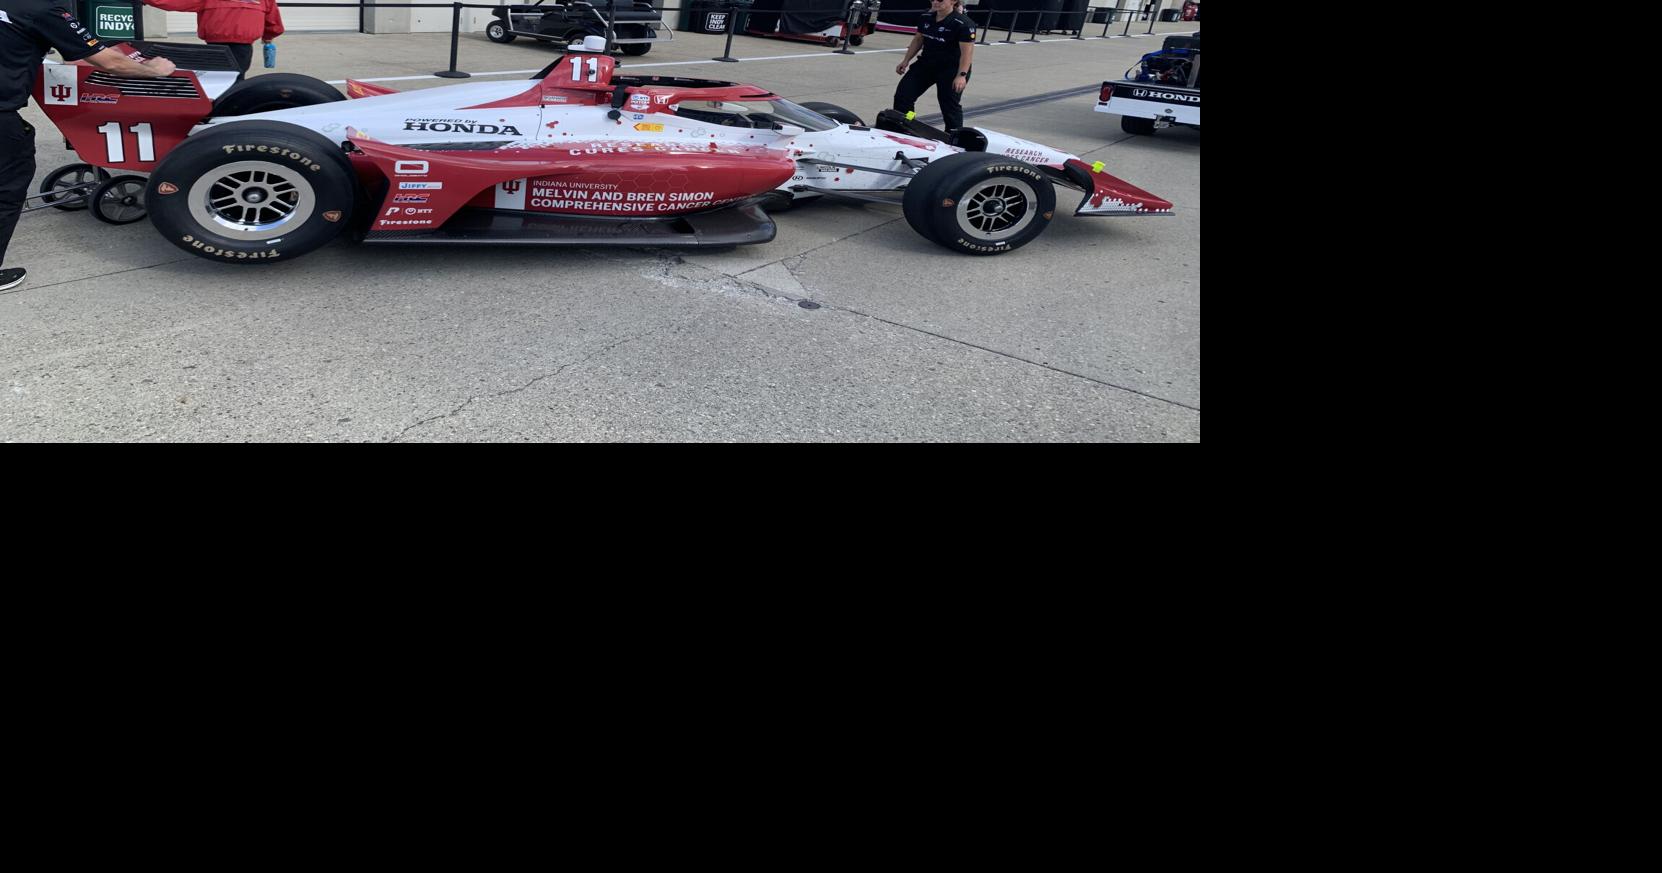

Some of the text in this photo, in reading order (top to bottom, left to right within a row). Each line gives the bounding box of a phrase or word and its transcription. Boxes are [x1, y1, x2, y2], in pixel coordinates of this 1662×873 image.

[569, 56, 598, 82] 11
[403, 122, 523, 136] HONDA
[97, 121, 156, 163] 11
[222, 144, 321, 172] Firestone
[986, 164, 1042, 180] Firestone
[533, 180, 618, 190] INDIANA UNIVERSITY
[532, 188, 714, 202] MELVIN AND BREN SIMON
[530, 198, 655, 212] COMPREHENSIVE
[657, 200, 711, 211] CANCER
[182, 235, 280, 259] Firestone
[957, 238, 1012, 252] Firestone
